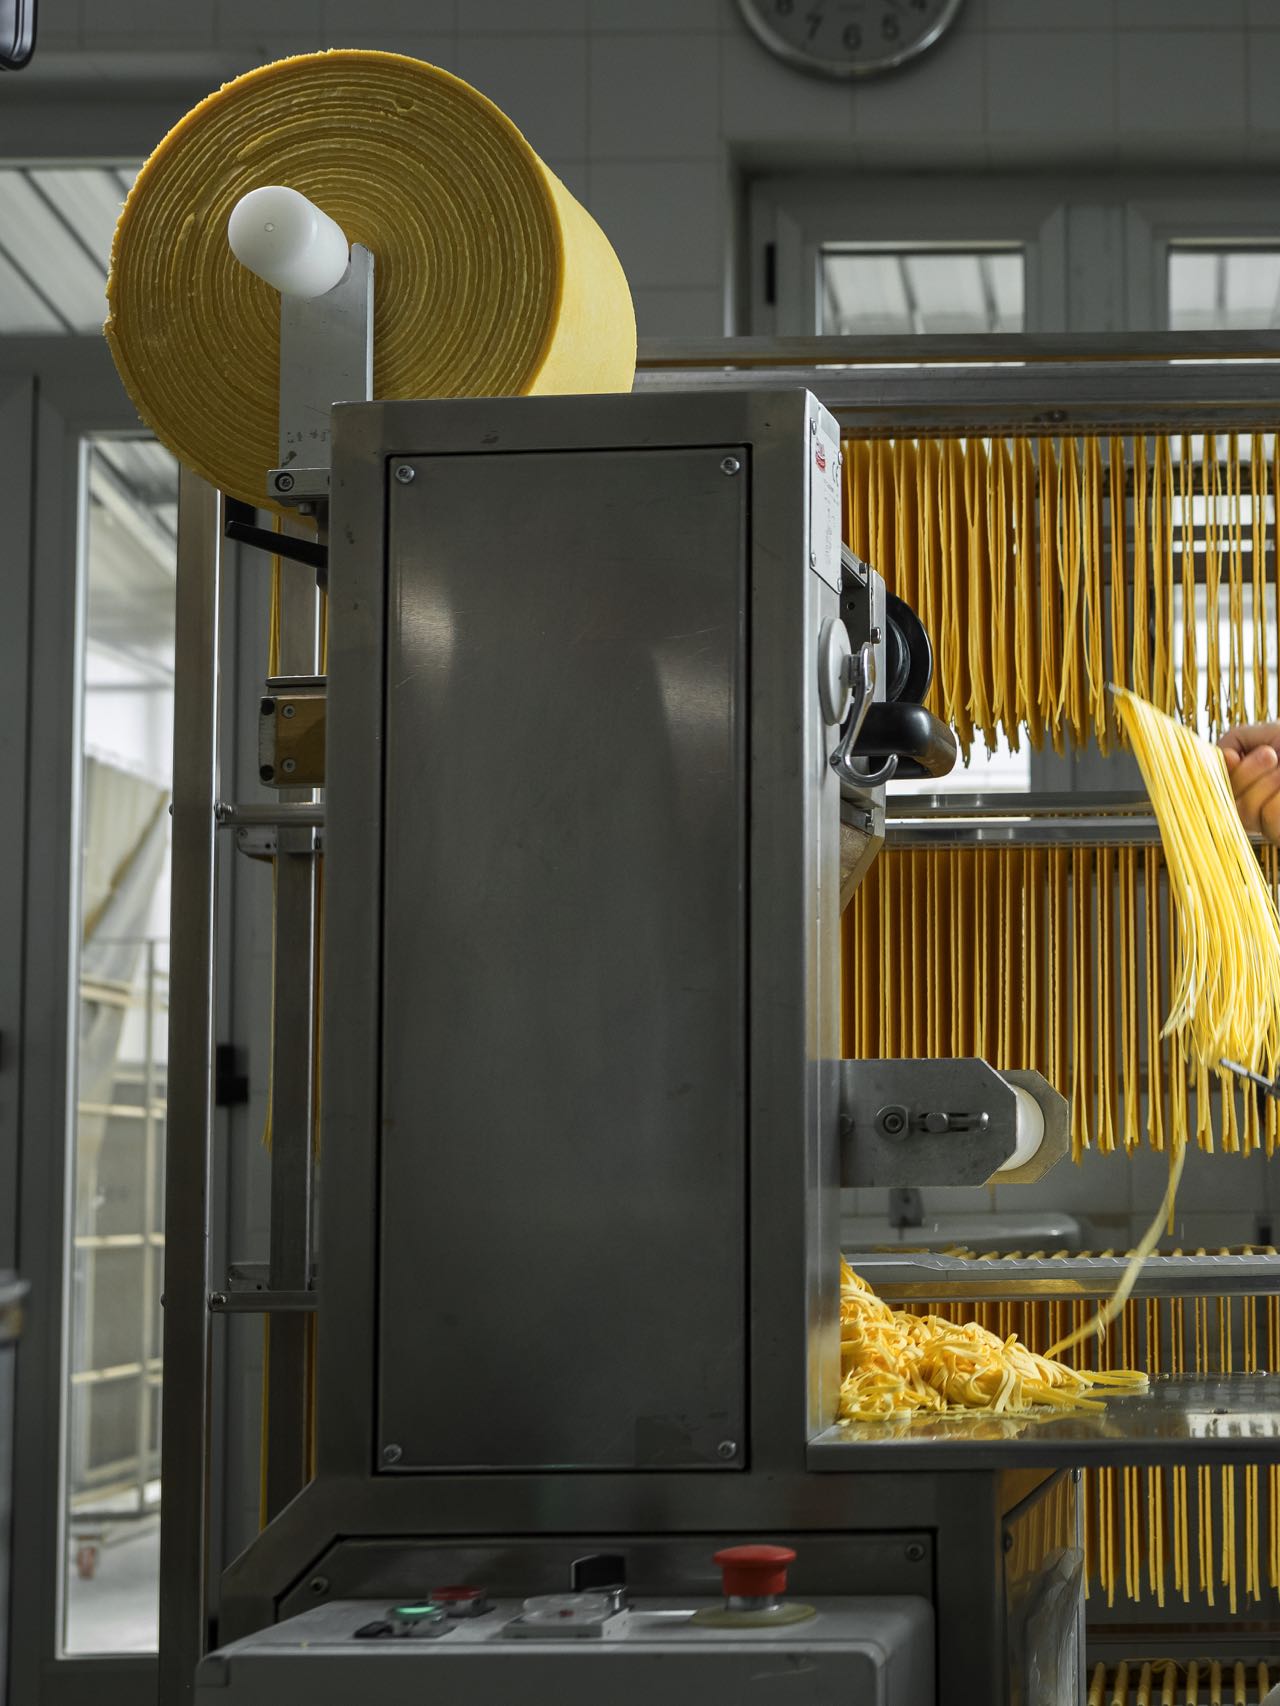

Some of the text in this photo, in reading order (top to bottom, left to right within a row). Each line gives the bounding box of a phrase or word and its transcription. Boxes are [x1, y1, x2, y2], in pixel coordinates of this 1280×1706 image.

[805, 12, 824, 41] 7
[842, 22, 862, 51] 6
[881, 13, 899, 42] 5
